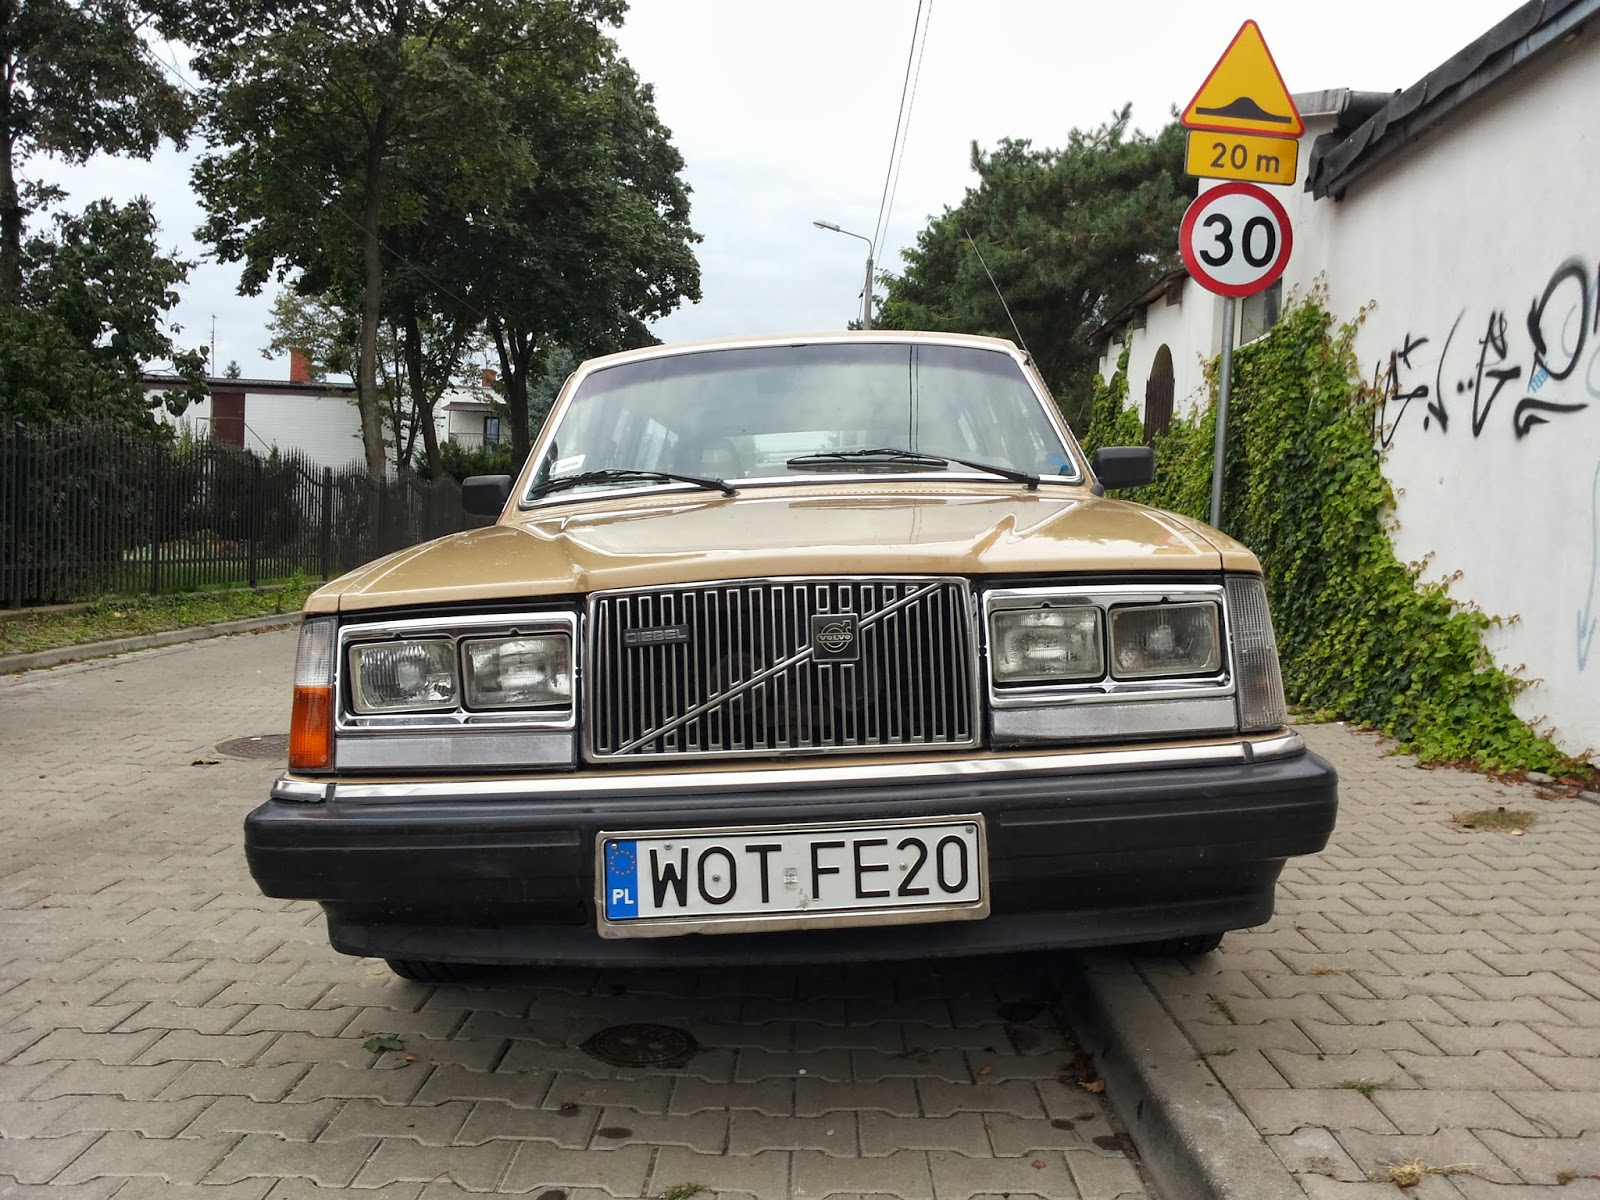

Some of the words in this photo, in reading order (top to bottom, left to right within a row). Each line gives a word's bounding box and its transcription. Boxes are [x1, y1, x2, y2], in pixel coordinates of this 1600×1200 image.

[1210, 142, 1248, 170] 20
[1256, 154, 1280, 173] m
[1199, 213, 1276, 268] 30
[625, 629, 687, 643] DIESEL
[649, 844, 782, 908] WOT
[809, 835, 969, 899] FE20
[612, 888, 635, 905] PL
